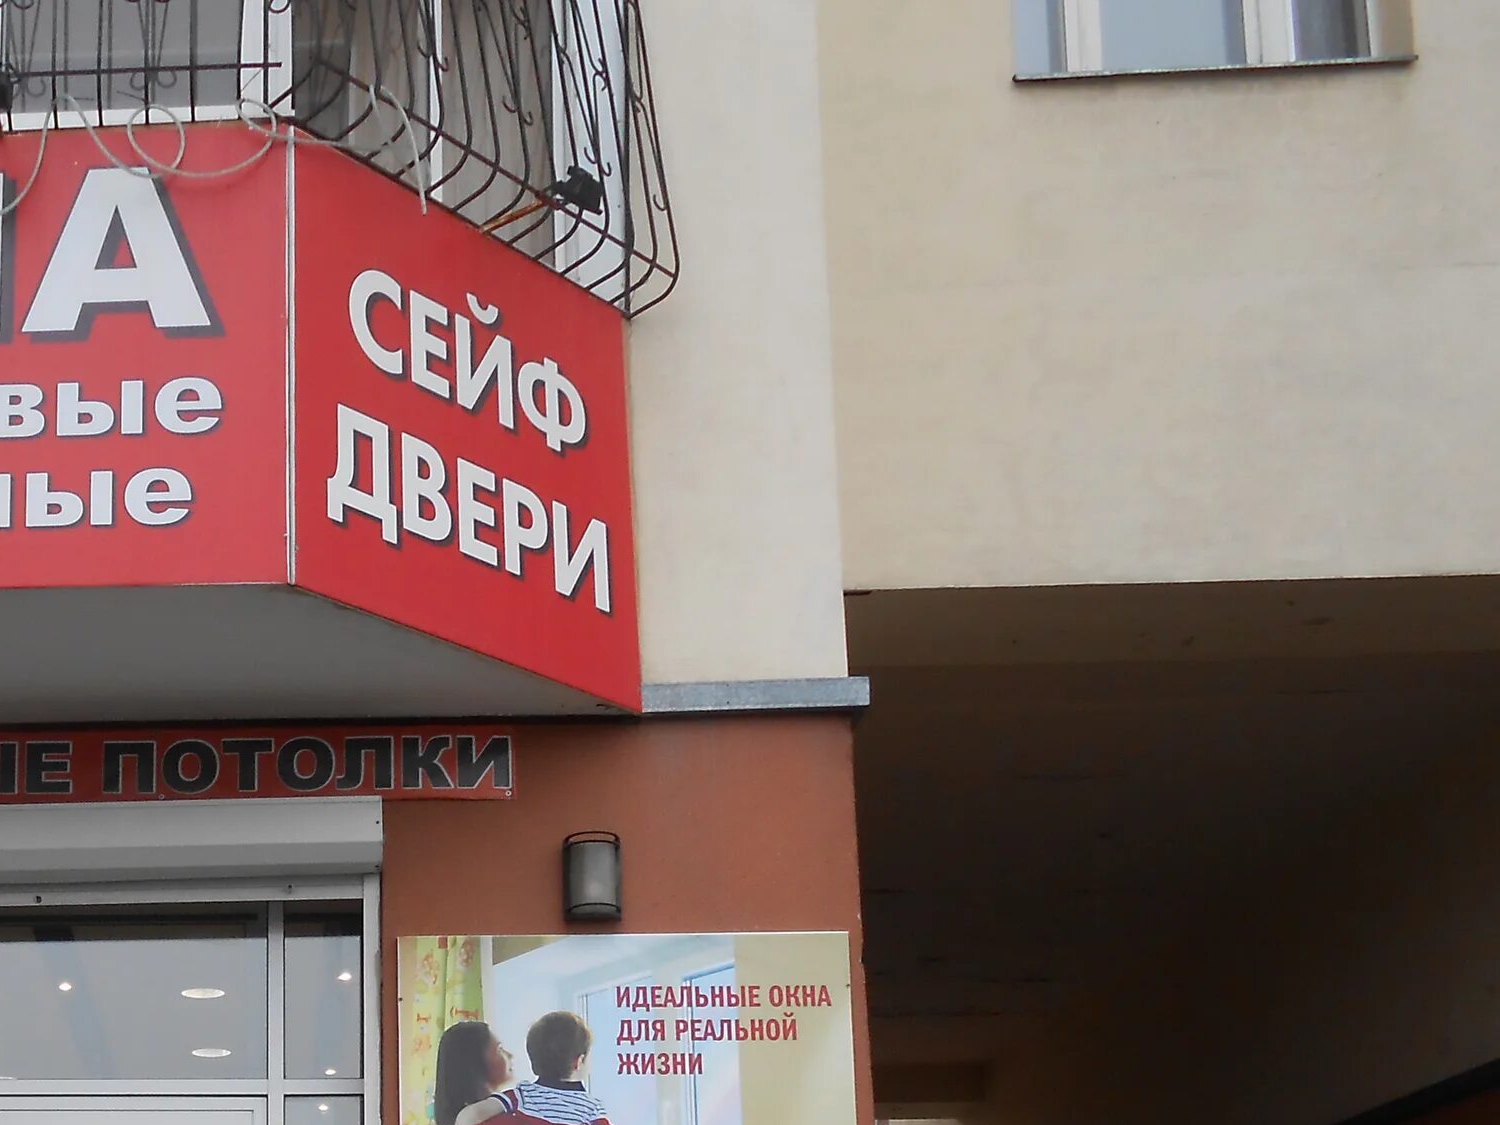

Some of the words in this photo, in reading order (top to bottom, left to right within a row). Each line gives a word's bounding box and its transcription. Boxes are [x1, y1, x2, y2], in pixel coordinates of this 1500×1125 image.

[348, 269, 588, 453] СЕЙФ
[326, 403, 611, 613] ДВЕРИ
[102, 734, 512, 794] ПОТОЛКИ
[615, 985, 761, 1012] ИДЕАЛЬНЫЕ
[768, 985, 833, 1008] ОКНА
[616, 1018, 666, 1045] ДЛЯ
[675, 1012, 798, 1041] РЕАЛЬНОЙ
[617, 1052, 704, 1076] ЖИЗНИ
